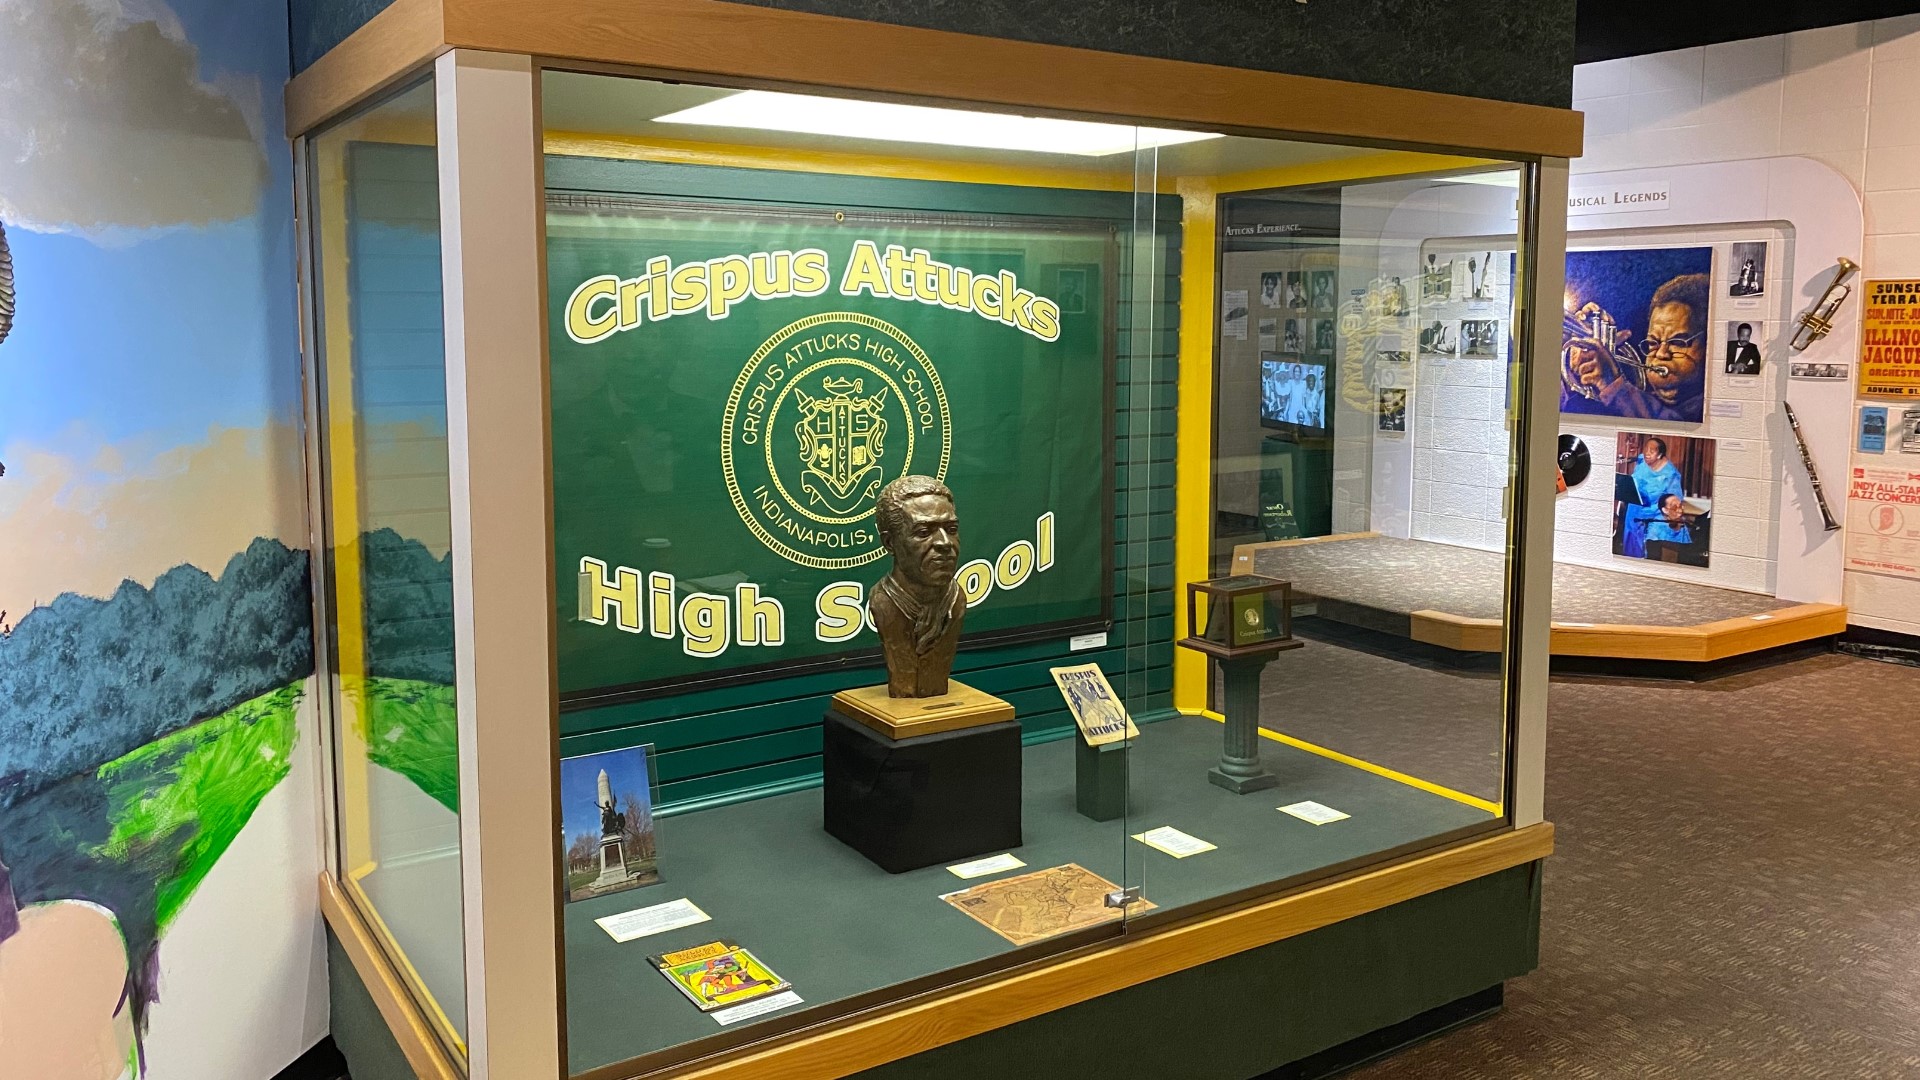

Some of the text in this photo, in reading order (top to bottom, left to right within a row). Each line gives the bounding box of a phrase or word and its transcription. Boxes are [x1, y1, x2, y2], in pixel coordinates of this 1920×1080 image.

[1569, 191, 1667, 207] USICAL LEGENDS
[1225, 226, 1254, 236] ATTUCKS
[565, 239, 1060, 345] Crispus Attucks
[1871, 294, 1920, 304] TERRA
[742, 333, 934, 445] CRISPUS ATTUCKS HIGH SCHOOL
[816, 414, 869, 433] H S
[837, 405, 847, 485] ATTUCKS
[1853, 481, 1877, 491] INDY
[1848, 490, 1874, 500] JAZZ
[752, 484, 874, 548] INDIANAPOLIS,
[579, 511, 1055, 658] High Sool
[1059, 669, 1097, 681] CRISPUS
[1088, 721, 1126, 736] ATTUCKS
